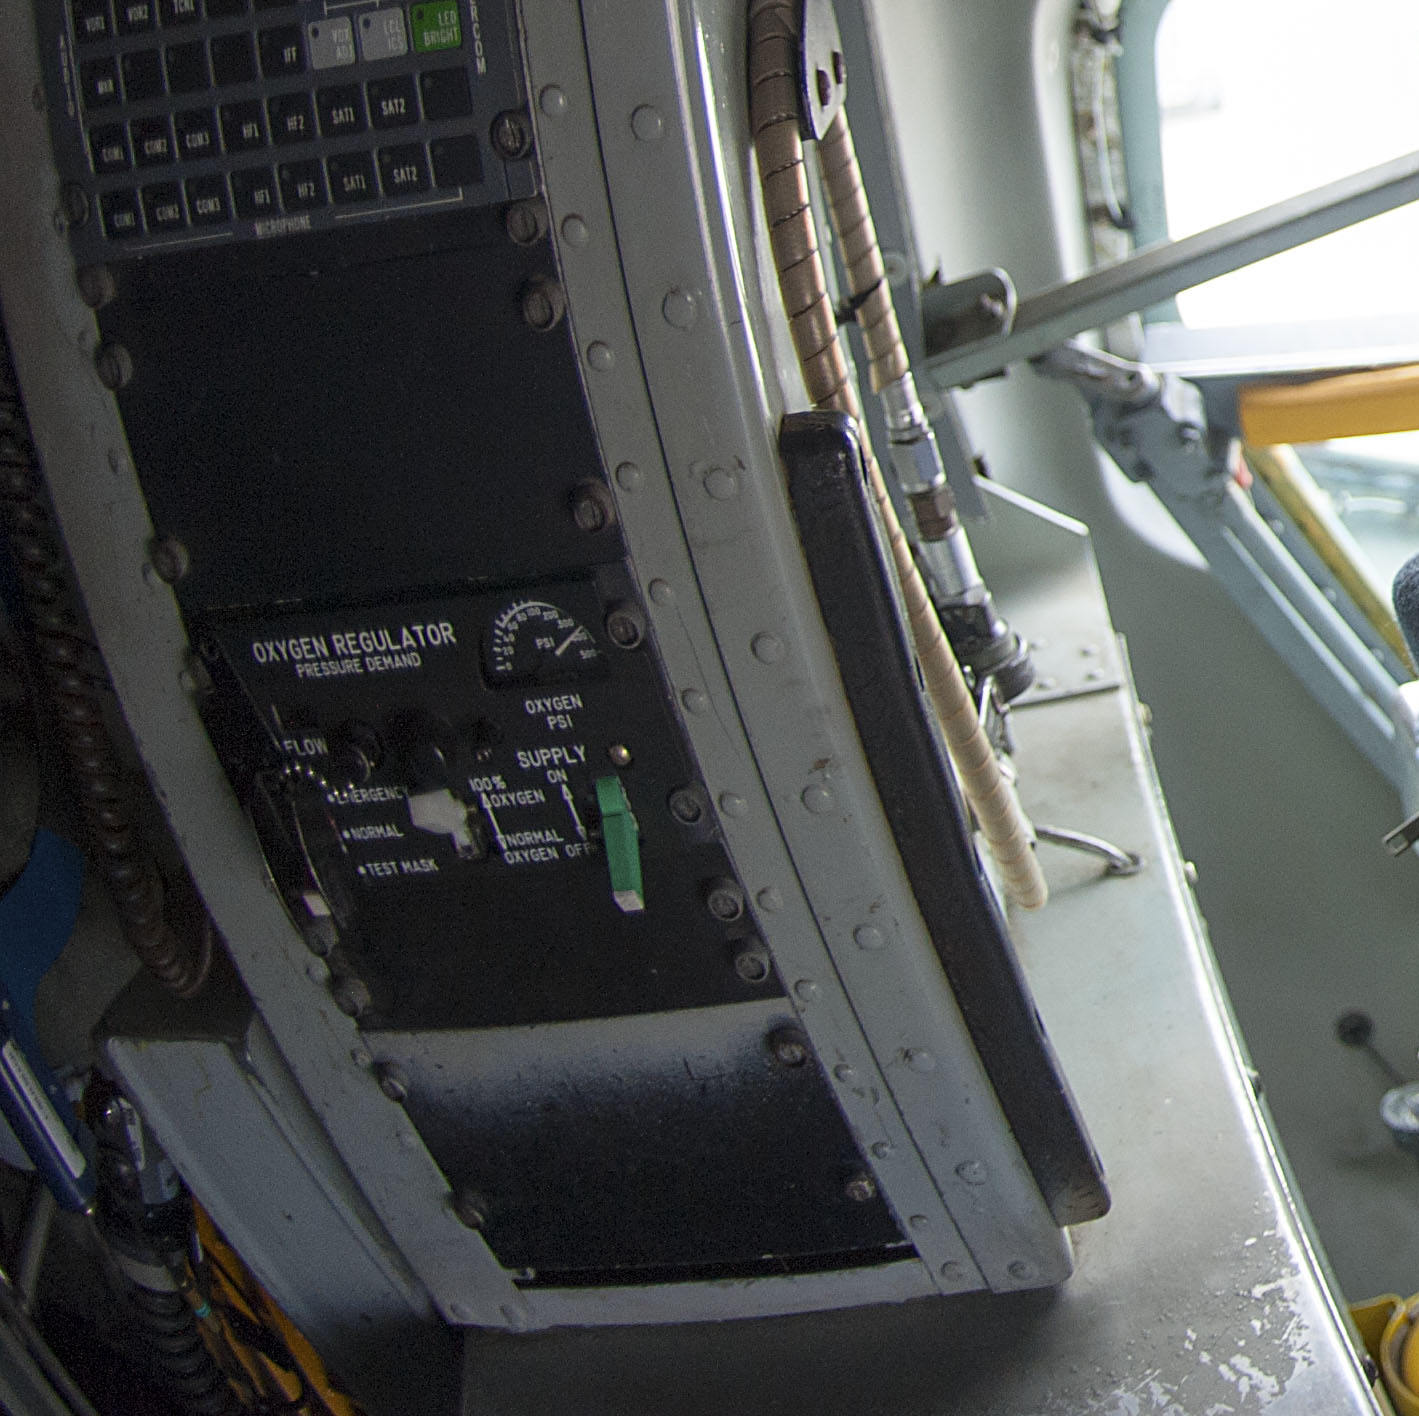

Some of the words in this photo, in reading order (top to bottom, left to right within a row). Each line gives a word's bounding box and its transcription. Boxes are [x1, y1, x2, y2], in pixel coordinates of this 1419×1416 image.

[437, 10, 457, 25] LED
[423, 27, 459, 46] BRIGHT
[331, 106, 356, 126] SAT1
[381, 97, 406, 116] SAT2
[241, 121, 260, 140] HF1
[286, 114, 305, 132] HF2
[342, 173, 367, 193] SAT1
[392, 165, 419, 184] SAT2
[253, 188, 271, 206] HF1
[297, 180, 316, 199] HF2
[254, 214, 312, 240] MICROPHONE
[251, 634, 330, 664] OXYGEN
[330, 620, 459, 658] REGULATOR
[533, 636, 556, 650] PSI
[294, 657, 365, 679] PRESSURE
[364, 651, 423, 671] DEMAND
[523, 693, 583, 715] OXYGEN
[546, 714, 574, 731] PSI
[282, 736, 330, 757] FLOW
[515, 744, 587, 769] SUPPLY
[469, 774, 507, 792] 100%
[545, 768, 568, 784] ON
[490, 788, 546, 808] OXYGEN
[350, 823, 405, 841] NORMAL
[506, 829, 564, 847] NORMAL
[503, 847, 560, 866] OXYGEN
[564, 842, 592, 858] OFF
[365, 860, 399, 877] TEST
[401, 857, 440, 874] MASK
